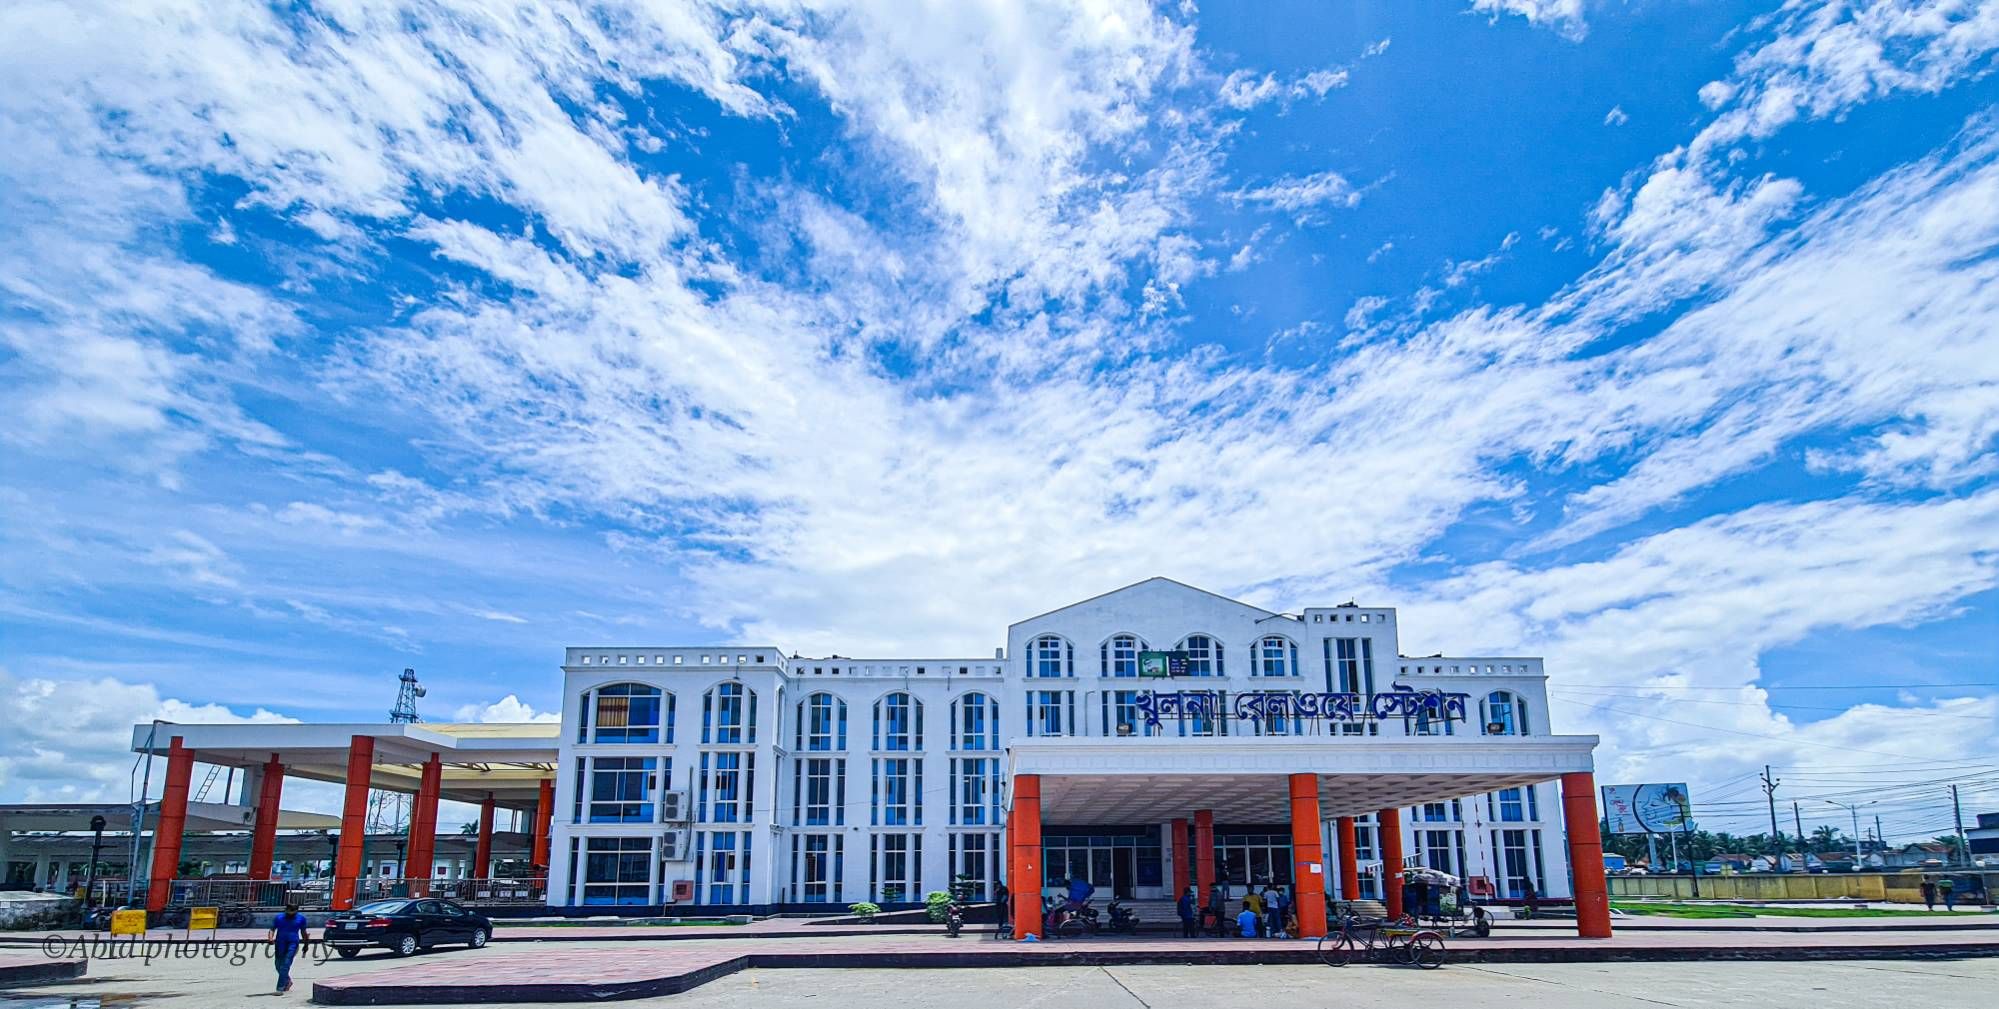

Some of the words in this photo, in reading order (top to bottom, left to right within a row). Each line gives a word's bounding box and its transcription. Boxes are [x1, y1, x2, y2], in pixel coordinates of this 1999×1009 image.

[1136, 690, 1217, 729] খুলনা
[1235, 692, 1357, 722] রেলওয়ে
[1372, 681, 1472, 724] স্টেশন
